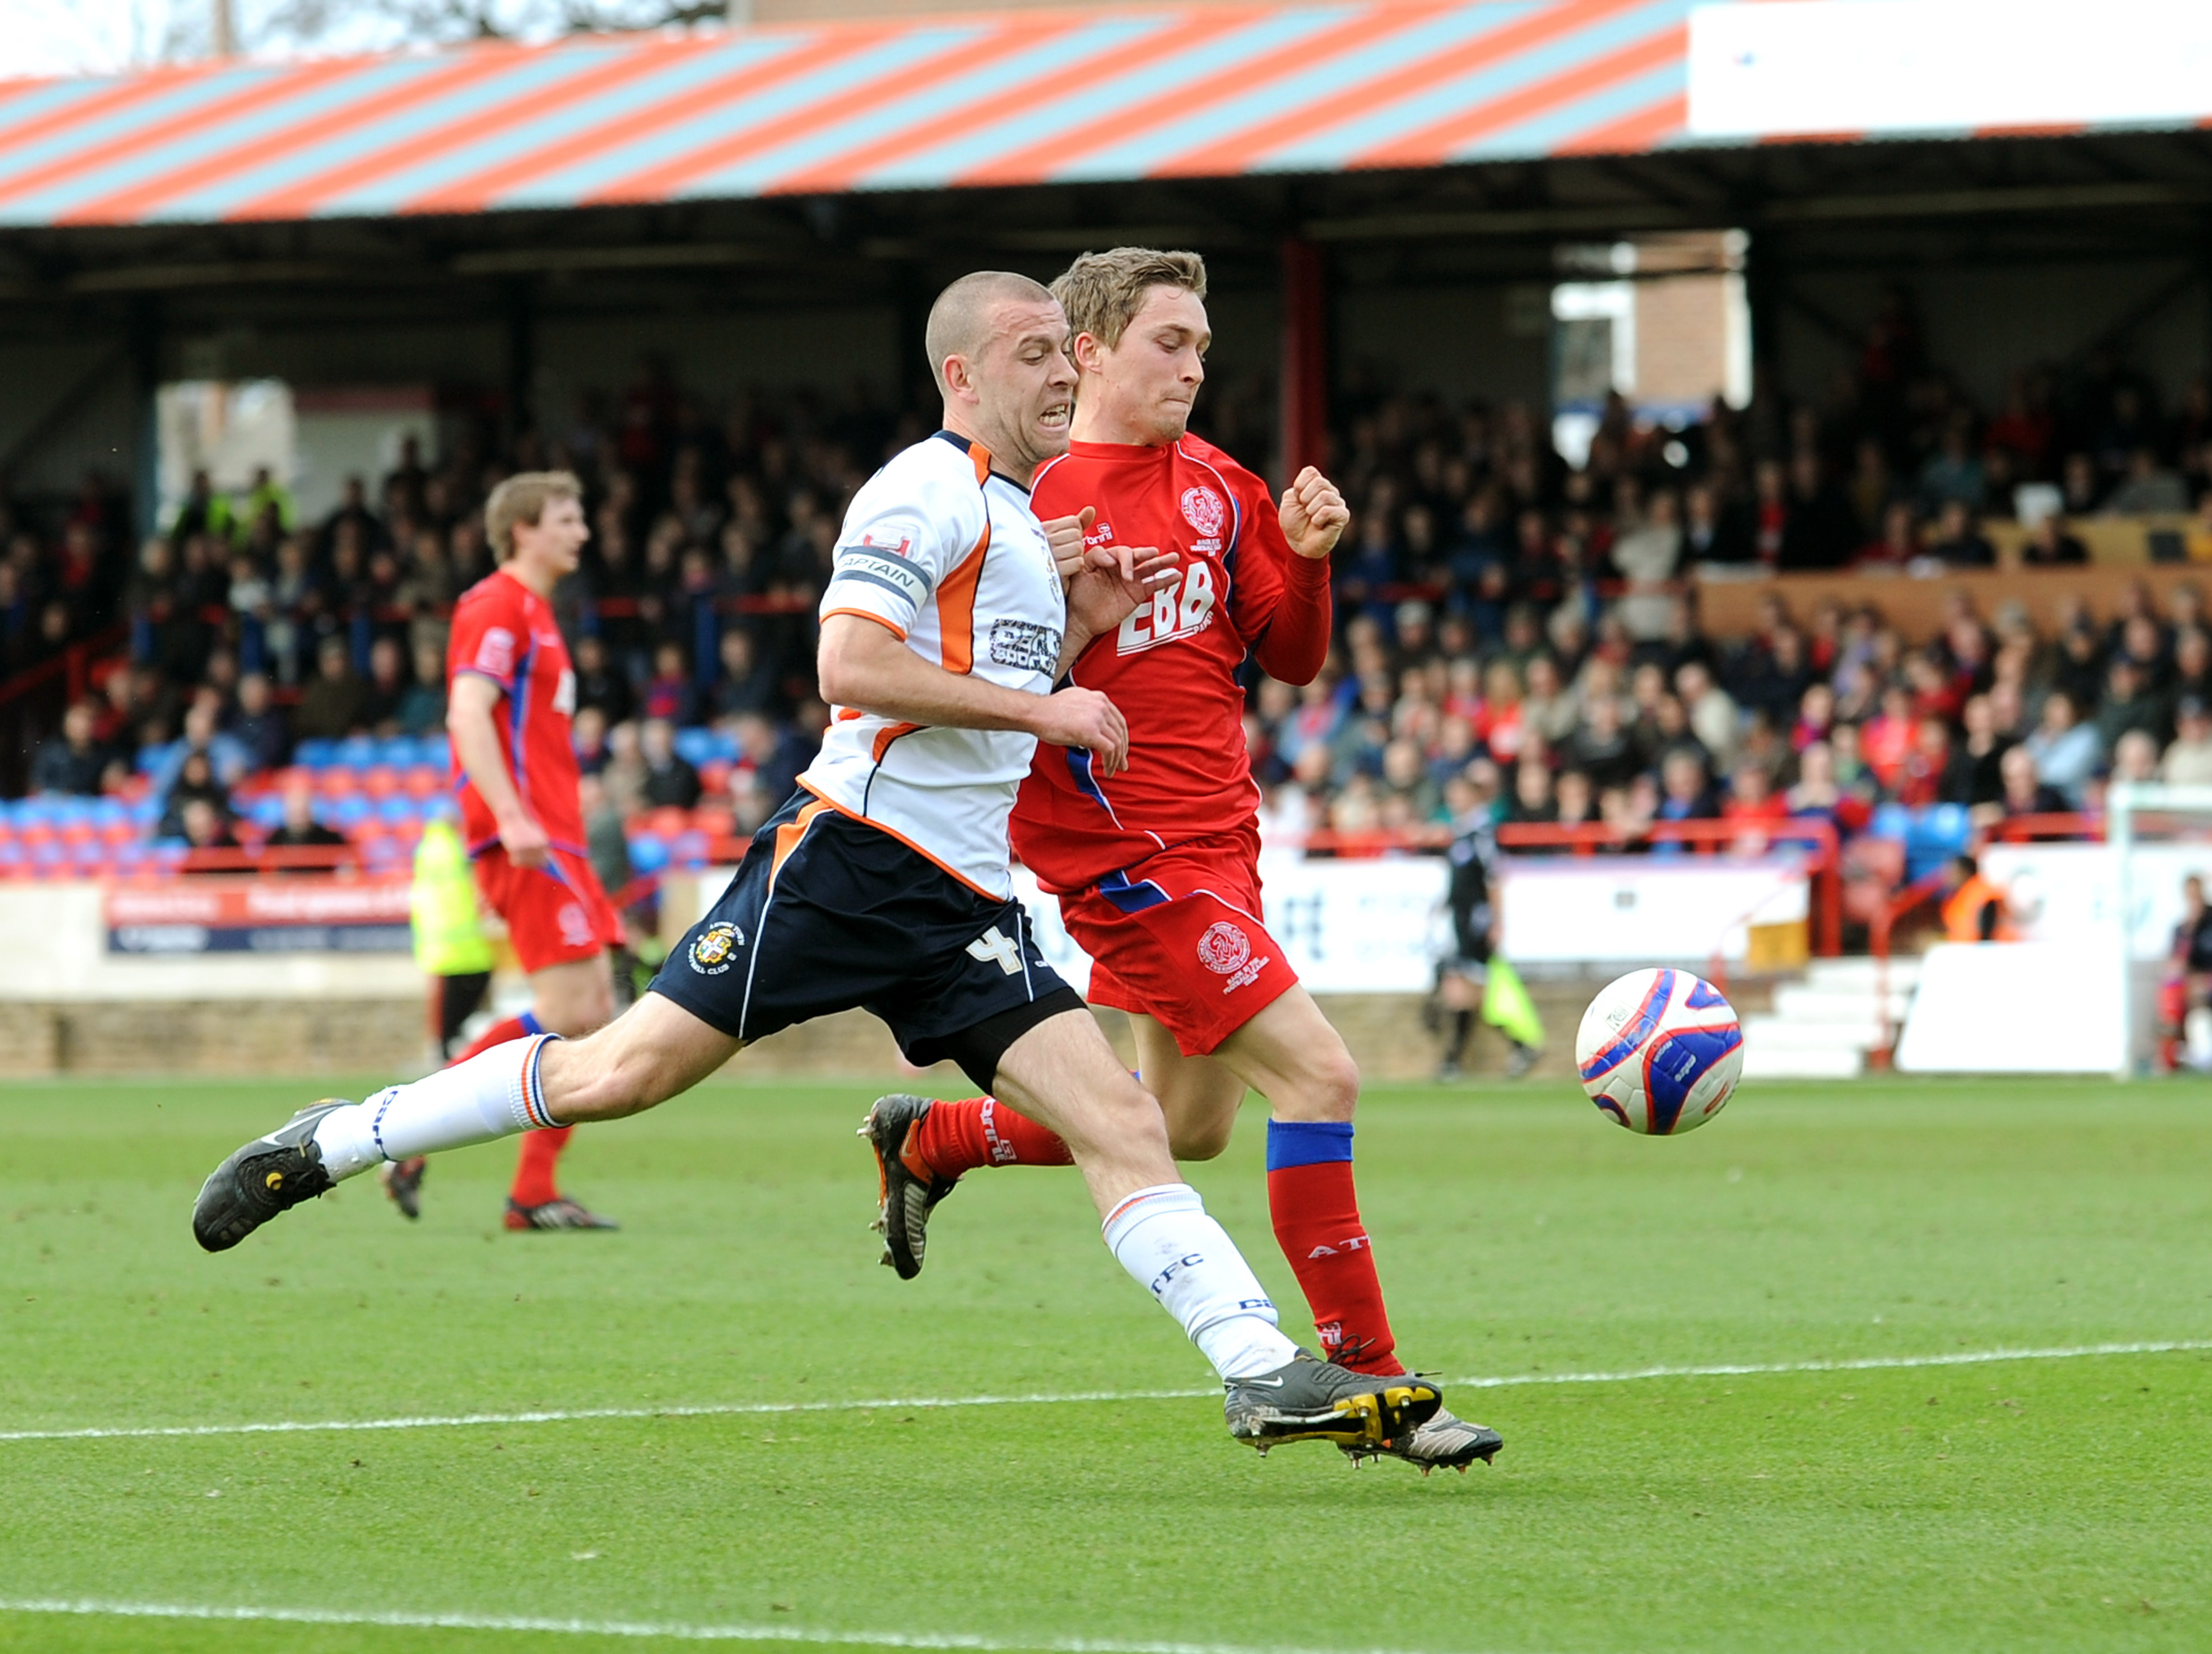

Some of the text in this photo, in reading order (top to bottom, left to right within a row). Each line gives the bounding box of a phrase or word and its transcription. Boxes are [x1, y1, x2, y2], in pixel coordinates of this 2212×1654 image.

[840, 558, 915, 588] APTAIN
[965, 925, 1023, 976] 4
[1151, 1253, 1204, 1294] TFC
